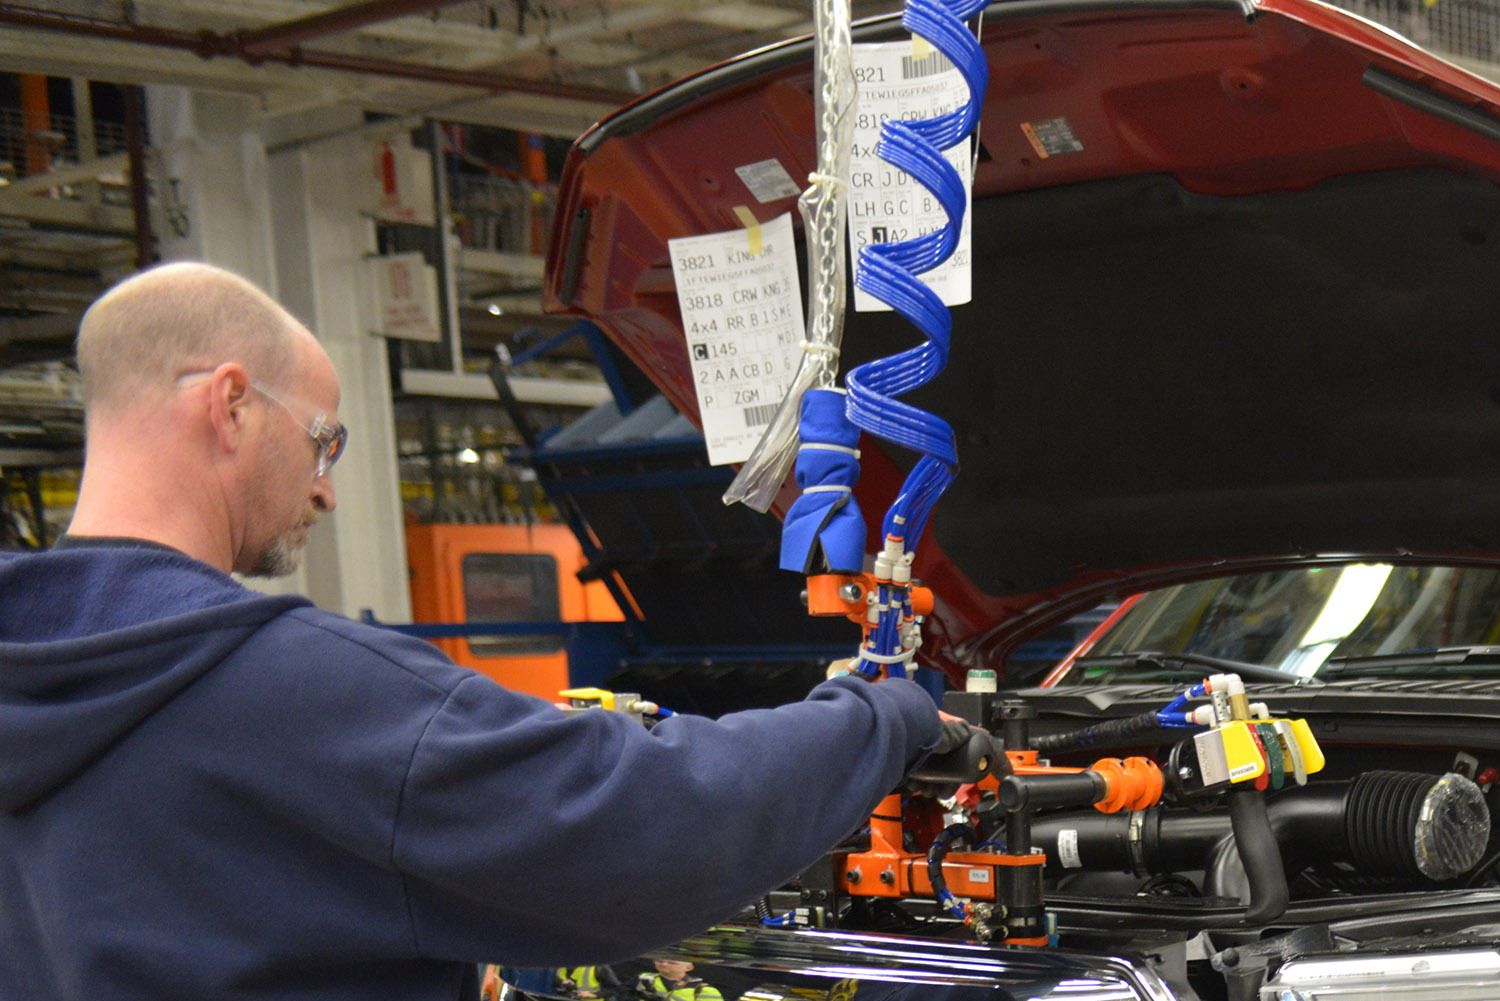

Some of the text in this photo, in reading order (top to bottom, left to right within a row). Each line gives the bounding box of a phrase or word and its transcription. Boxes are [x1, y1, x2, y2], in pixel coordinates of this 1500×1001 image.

[854, 66, 886, 83] 821
[852, 172, 874, 188] CR
[882, 171, 892, 187] J
[897, 169, 908, 183] D
[854, 202, 876, 217] LH
[883, 201, 894, 216] G
[899, 199, 909, 215] C
[923, 197, 932, 213] B
[856, 230, 868, 246] S
[678, 254, 715, 272] 3821
[686, 292, 724, 312] 3818
[732, 287, 758, 305] CRW
[690, 319, 719, 335] 4x4
[726, 315, 745, 331] RR
[750, 312, 759, 327] B
[711, 342, 738, 358] 145
[699, 370, 709, 385] 2
[714, 369, 726, 383] A
[729, 367, 740, 381] A
[742, 363, 761, 379] CB
[704, 395, 714, 409] P
[734, 389, 761, 406] ZGM
